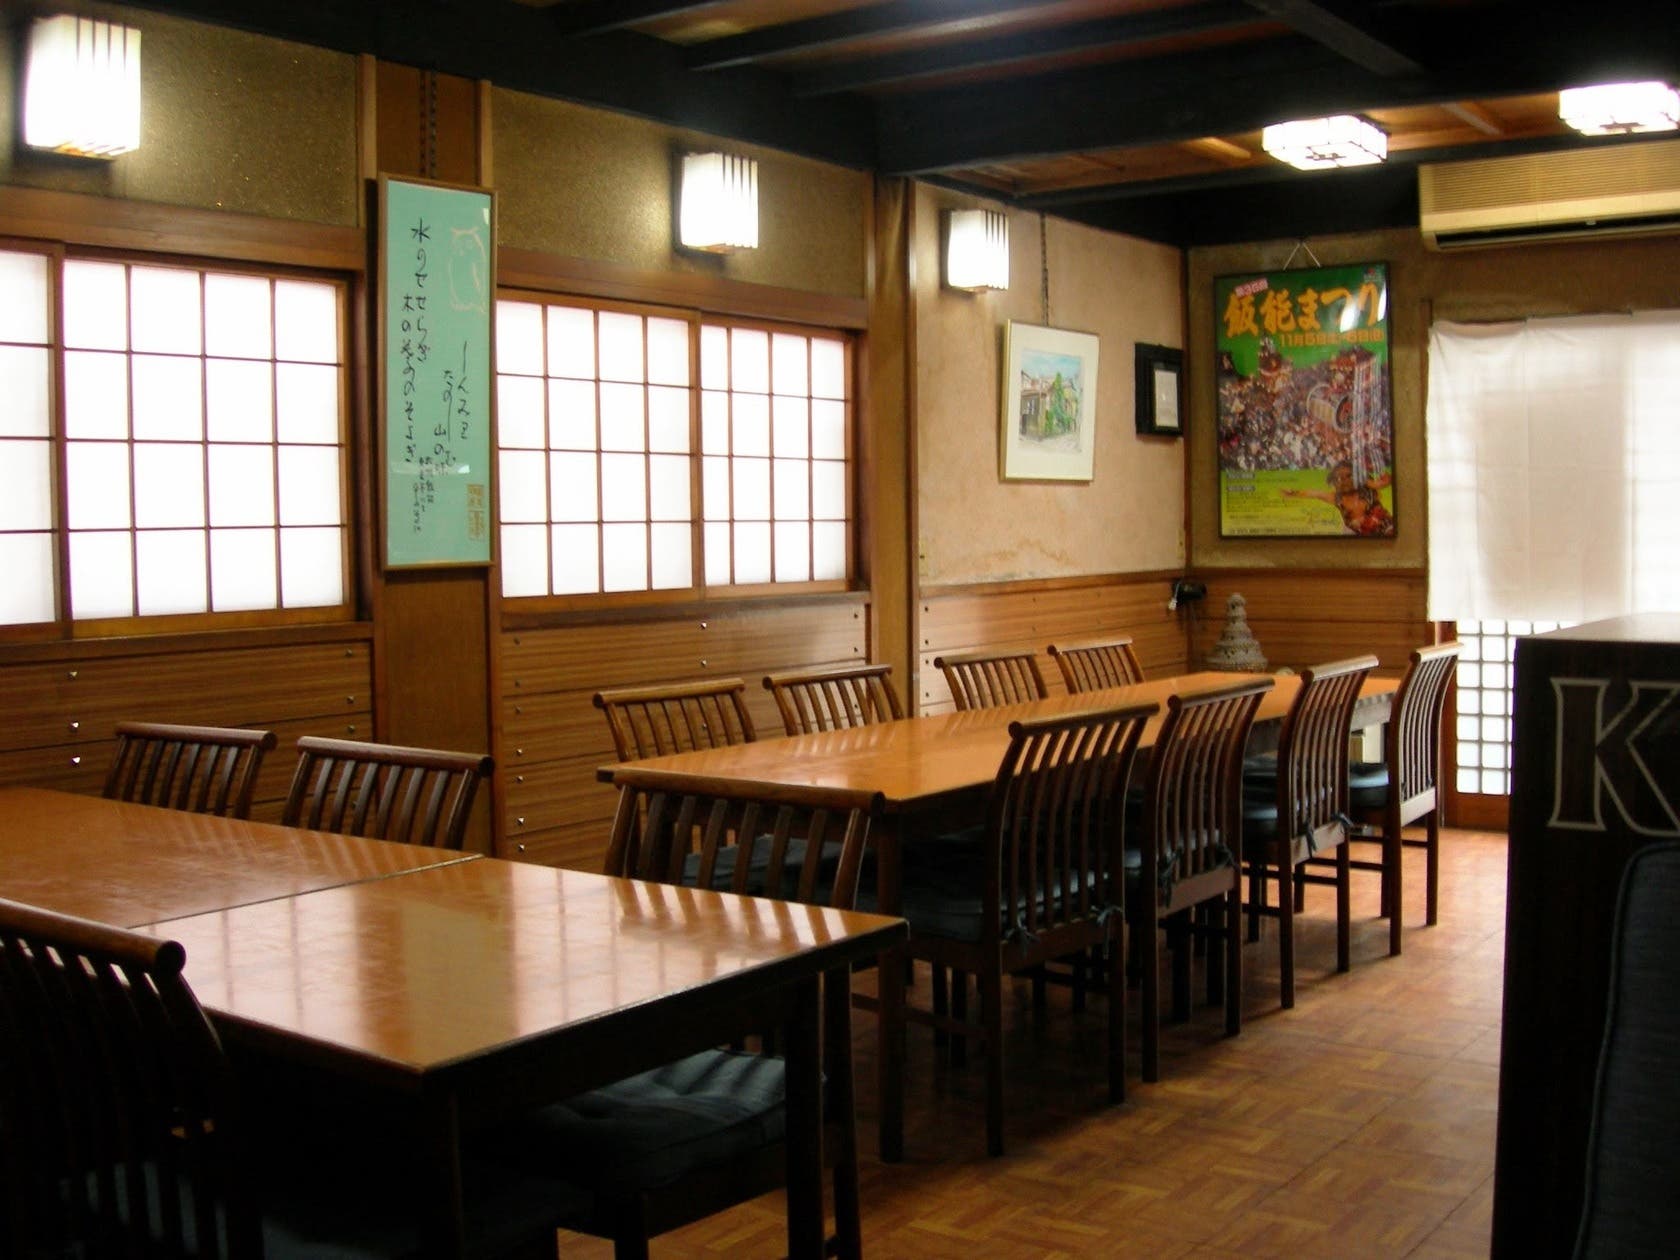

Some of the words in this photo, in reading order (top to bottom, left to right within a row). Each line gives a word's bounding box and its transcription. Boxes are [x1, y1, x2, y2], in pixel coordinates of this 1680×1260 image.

[1224, 282, 1380, 338] 飯能まつり
[1547, 677, 1680, 838] K
